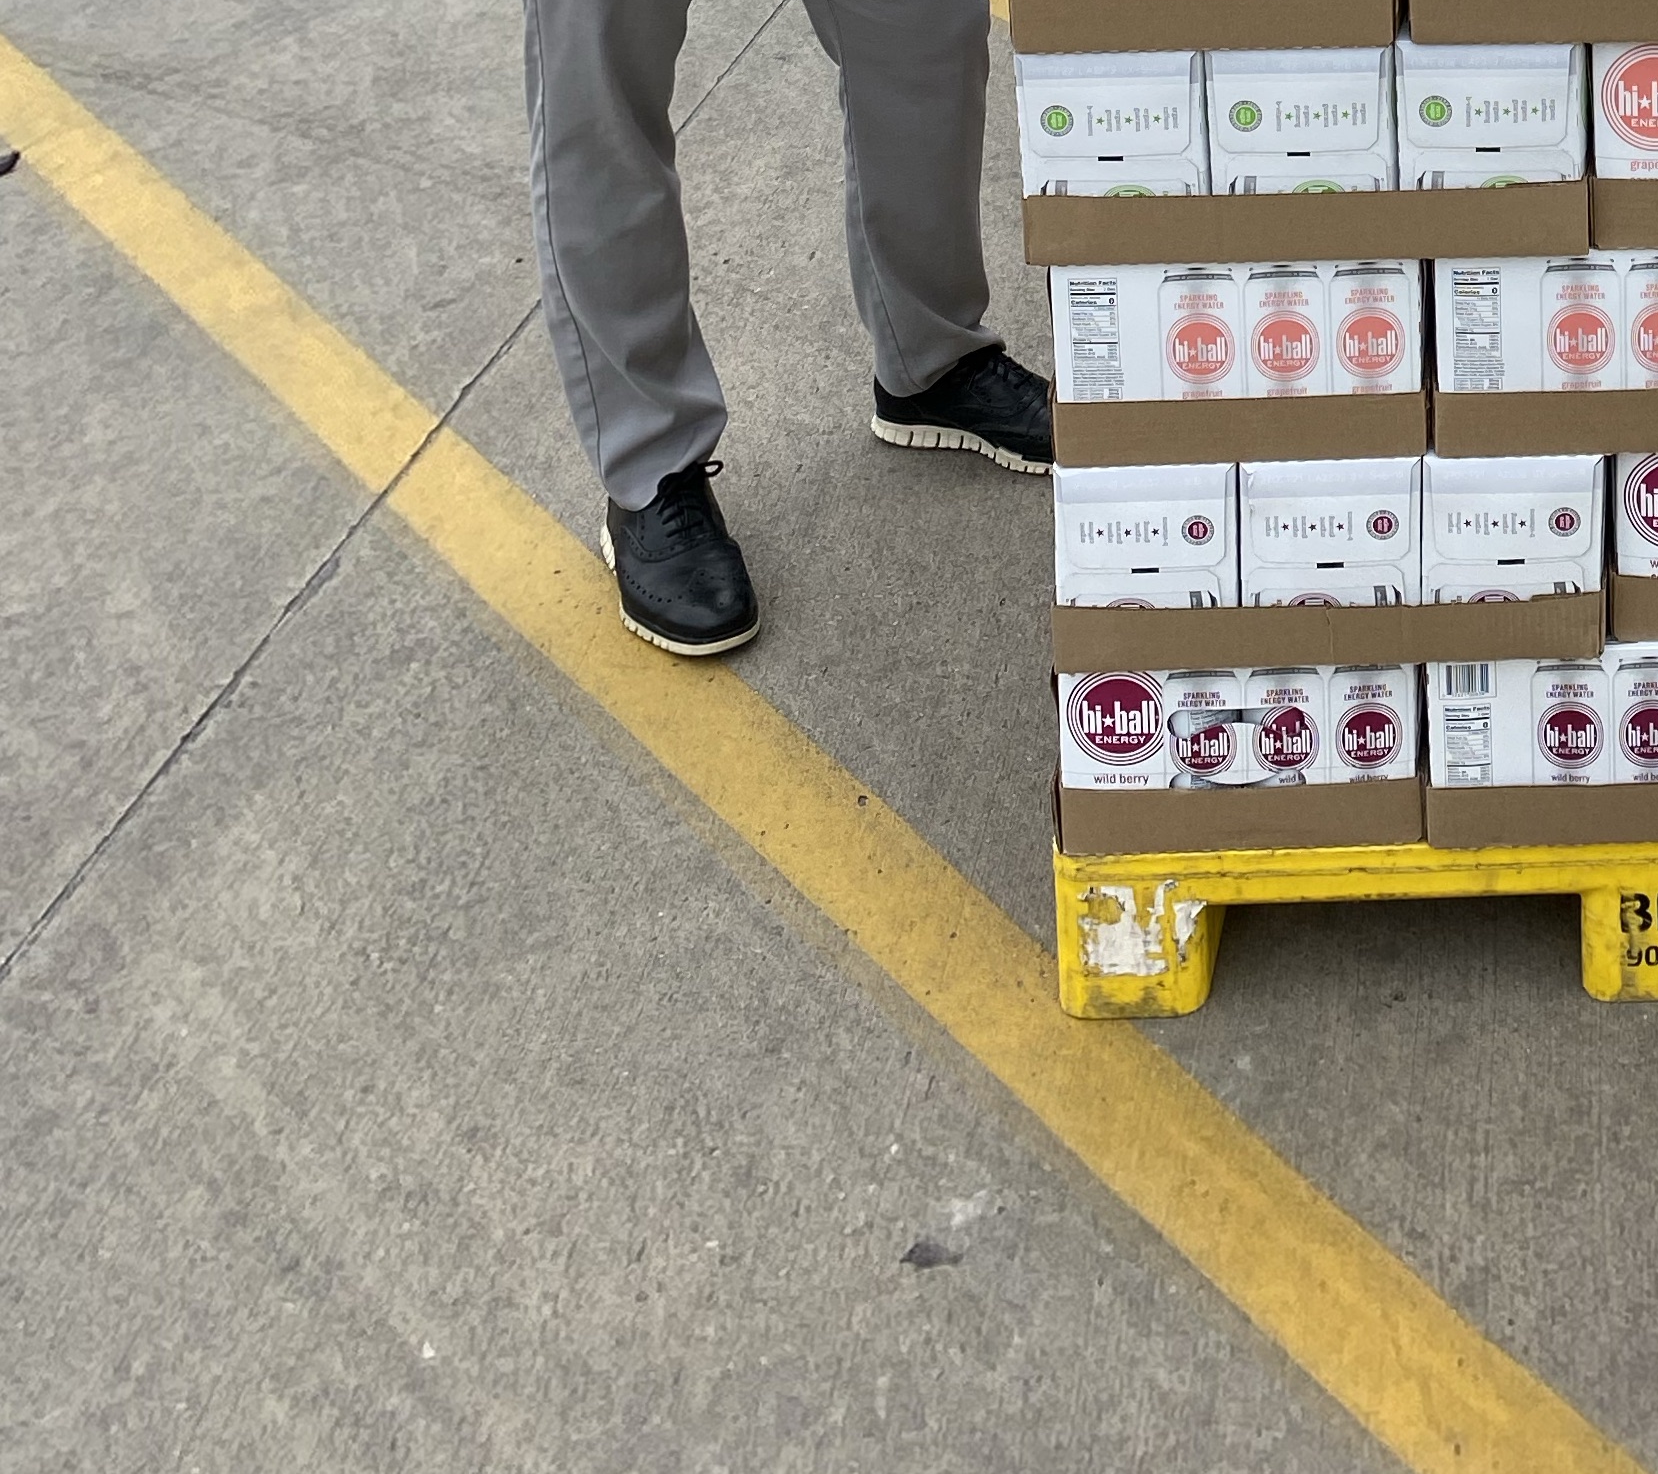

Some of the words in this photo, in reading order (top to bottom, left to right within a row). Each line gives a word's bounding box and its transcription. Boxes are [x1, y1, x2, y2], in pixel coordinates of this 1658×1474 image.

[1352, 355, 1392, 364] ENERGY
[1352, 384, 1393, 395] grapefruit
[1095, 735, 1146, 745] ENERGY
[1094, 774, 1117, 785] wild
[1119, 773, 1149, 787] berry
